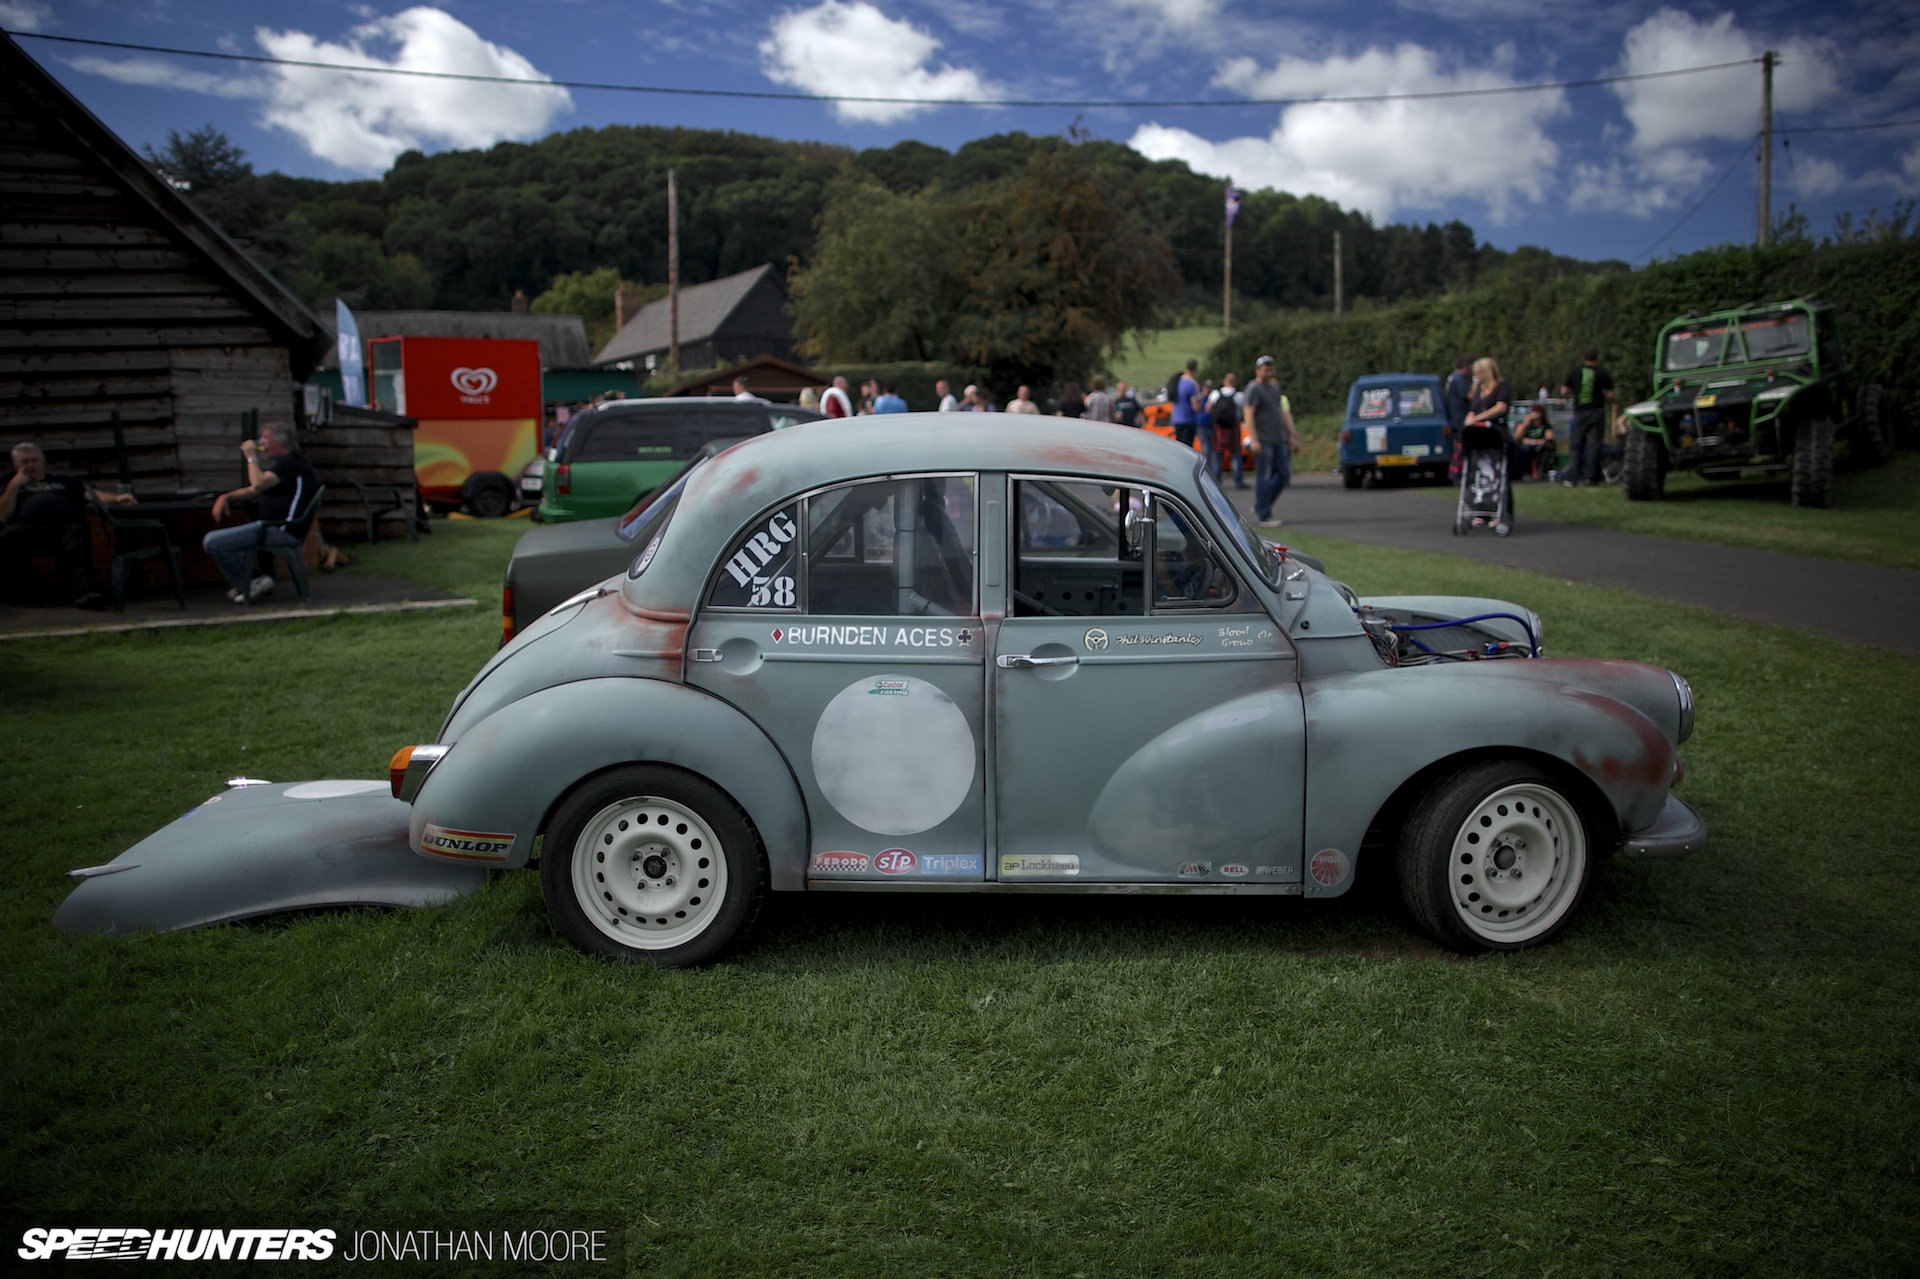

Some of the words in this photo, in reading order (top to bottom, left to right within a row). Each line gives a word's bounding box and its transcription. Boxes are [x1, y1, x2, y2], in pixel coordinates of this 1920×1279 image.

[724, 511, 796, 588] HRG
[751, 576, 795, 606] 58
[787, 626, 887, 646] BURNDEN
[894, 627, 953, 647] ACES
[1140, 633, 1204, 647] Winstanley
[880, 689, 910, 697] racing
[422, 833, 508, 853] DUNLOP
[815, 856, 869, 867] FERODO
[880, 851, 912, 871] STP
[923, 856, 978, 873] Triplex
[1021, 858, 1076, 871] Lockheed
[1223, 866, 1246, 874] BELL
[1265, 866, 1295, 875] WEBER
